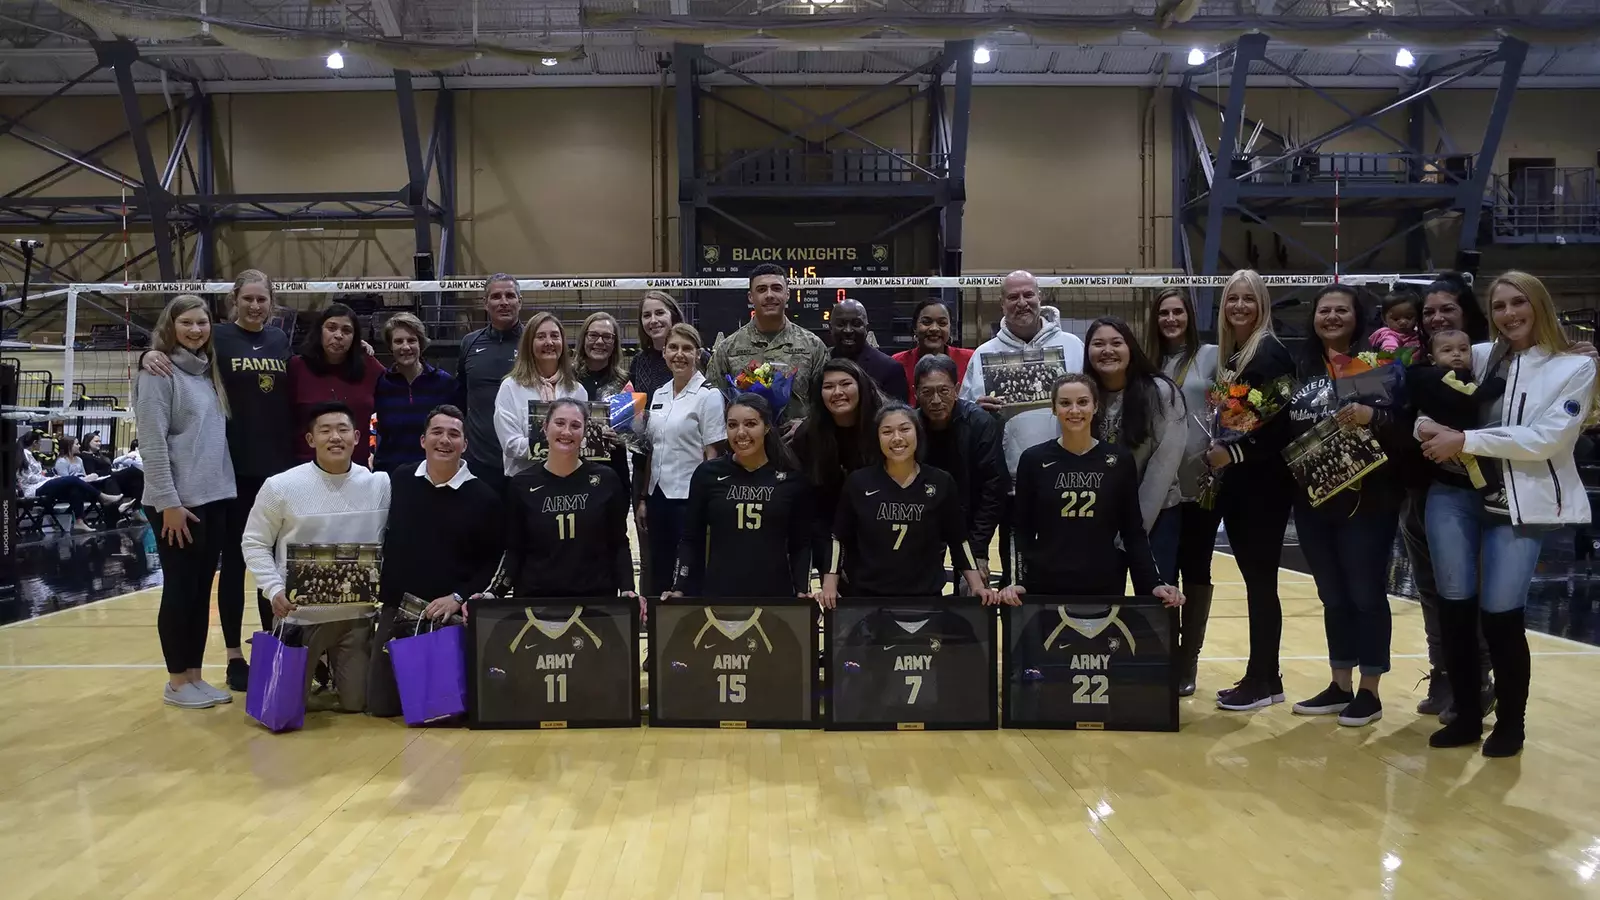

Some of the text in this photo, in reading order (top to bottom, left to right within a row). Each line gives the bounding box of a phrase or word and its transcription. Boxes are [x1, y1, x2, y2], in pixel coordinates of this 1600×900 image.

[732, 247, 857, 261] BLACK KNIGHTS
[184, 283, 206, 291] POINT
[344, 282, 366, 290] ARMY
[366, 282, 388, 290] WEST
[447, 281, 486, 289] ARMY WES
[550, 280, 572, 288] ARMY
[594, 279, 616, 287] POINT
[654, 279, 676, 287] ARMY
[676, 279, 698, 287] WEST
[788, 278, 801, 286] EST
[906, 277, 929, 285] POINT
[966, 277, 1002, 285] ARMY WES
[1068, 277, 1133, 285] ARMY WEST POINT
[1269, 275, 1333, 284] ARMY WEST POINT
[1290, 378, 1326, 405] UNITED
[1289, 408, 1318, 422] Military
[1054, 472, 1104, 489] ARMY
[726, 485, 775, 501] ARMY
[541, 493, 589, 513] ARMY
[1061, 491, 1096, 517] 22
[736, 503, 763, 529] 15
[876, 502, 925, 521] ARMY
[555, 513, 575, 540] 11
[892, 524, 908, 550] 7
[536, 653, 575, 670] ARMY
[713, 654, 751, 670] ARMY
[894, 655, 932, 671] ARMY
[1070, 654, 1110, 670] ARMY
[544, 674, 567, 703] 11
[717, 674, 746, 703] 15
[905, 675, 922, 704] 7
[1072, 674, 1109, 704] 22
